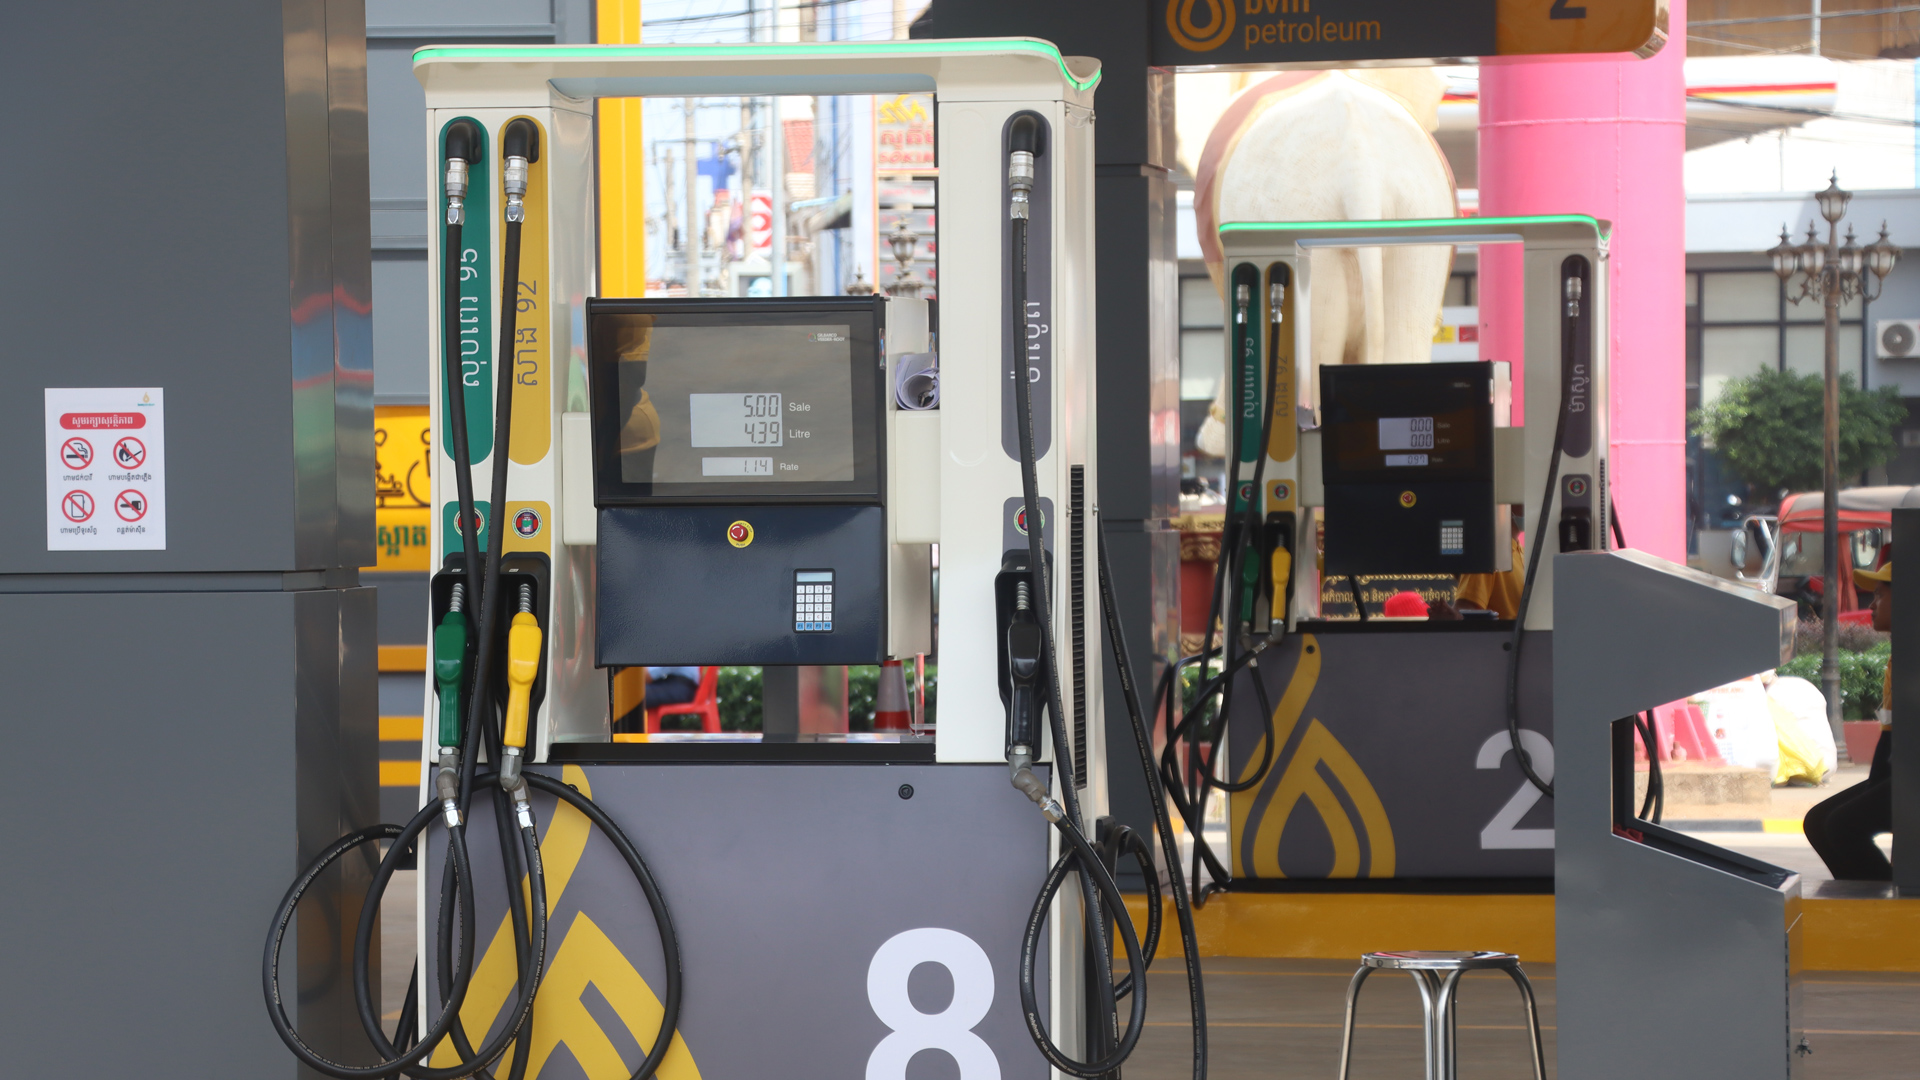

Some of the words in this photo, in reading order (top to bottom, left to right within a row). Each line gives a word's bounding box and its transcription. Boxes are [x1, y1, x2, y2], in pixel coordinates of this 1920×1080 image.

[1245, 15, 1381, 50] petroleum
[460, 248, 478, 281] 95
[516, 280, 537, 312] 92
[743, 394, 779, 417] 5.00
[789, 402, 811, 412] Sale
[744, 421, 780, 444] 4.39
[789, 429, 811, 438] Litre
[744, 459, 768, 473] 1.14
[780, 462, 799, 471] Rate
[1475, 729, 1554, 849] 2
[865, 927, 1002, 1080] 8
